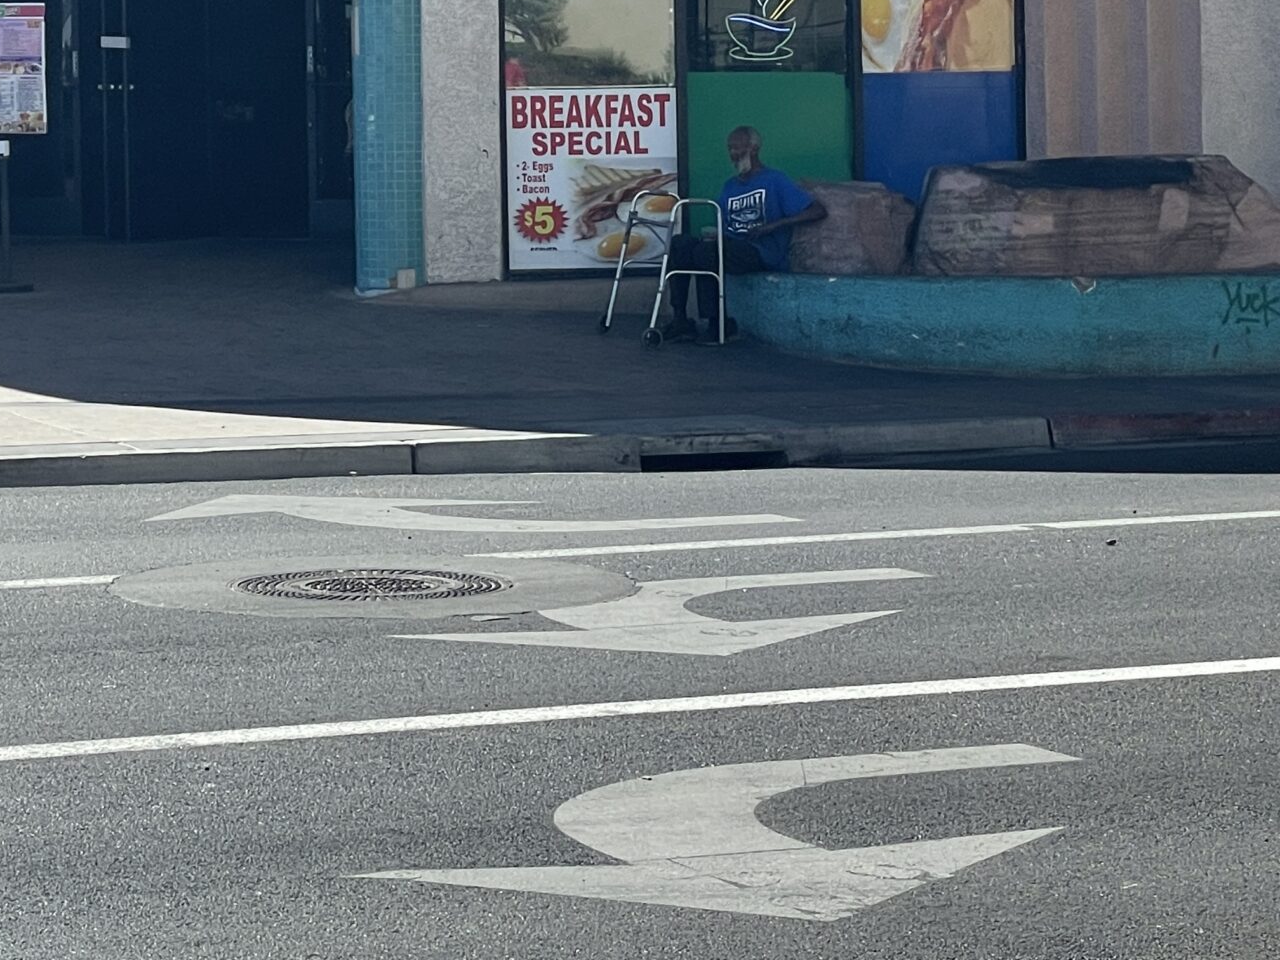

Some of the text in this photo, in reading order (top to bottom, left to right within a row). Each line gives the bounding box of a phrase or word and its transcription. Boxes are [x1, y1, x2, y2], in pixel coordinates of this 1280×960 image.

[511, 93, 670, 129] BREAKFAST
[531, 130, 648, 156] SPECIAL
[532, 161, 554, 173] Eggs
[522, 173, 546, 183] Toast
[522, 184, 550, 194] Bacon
[524, 205, 555, 235] $5
